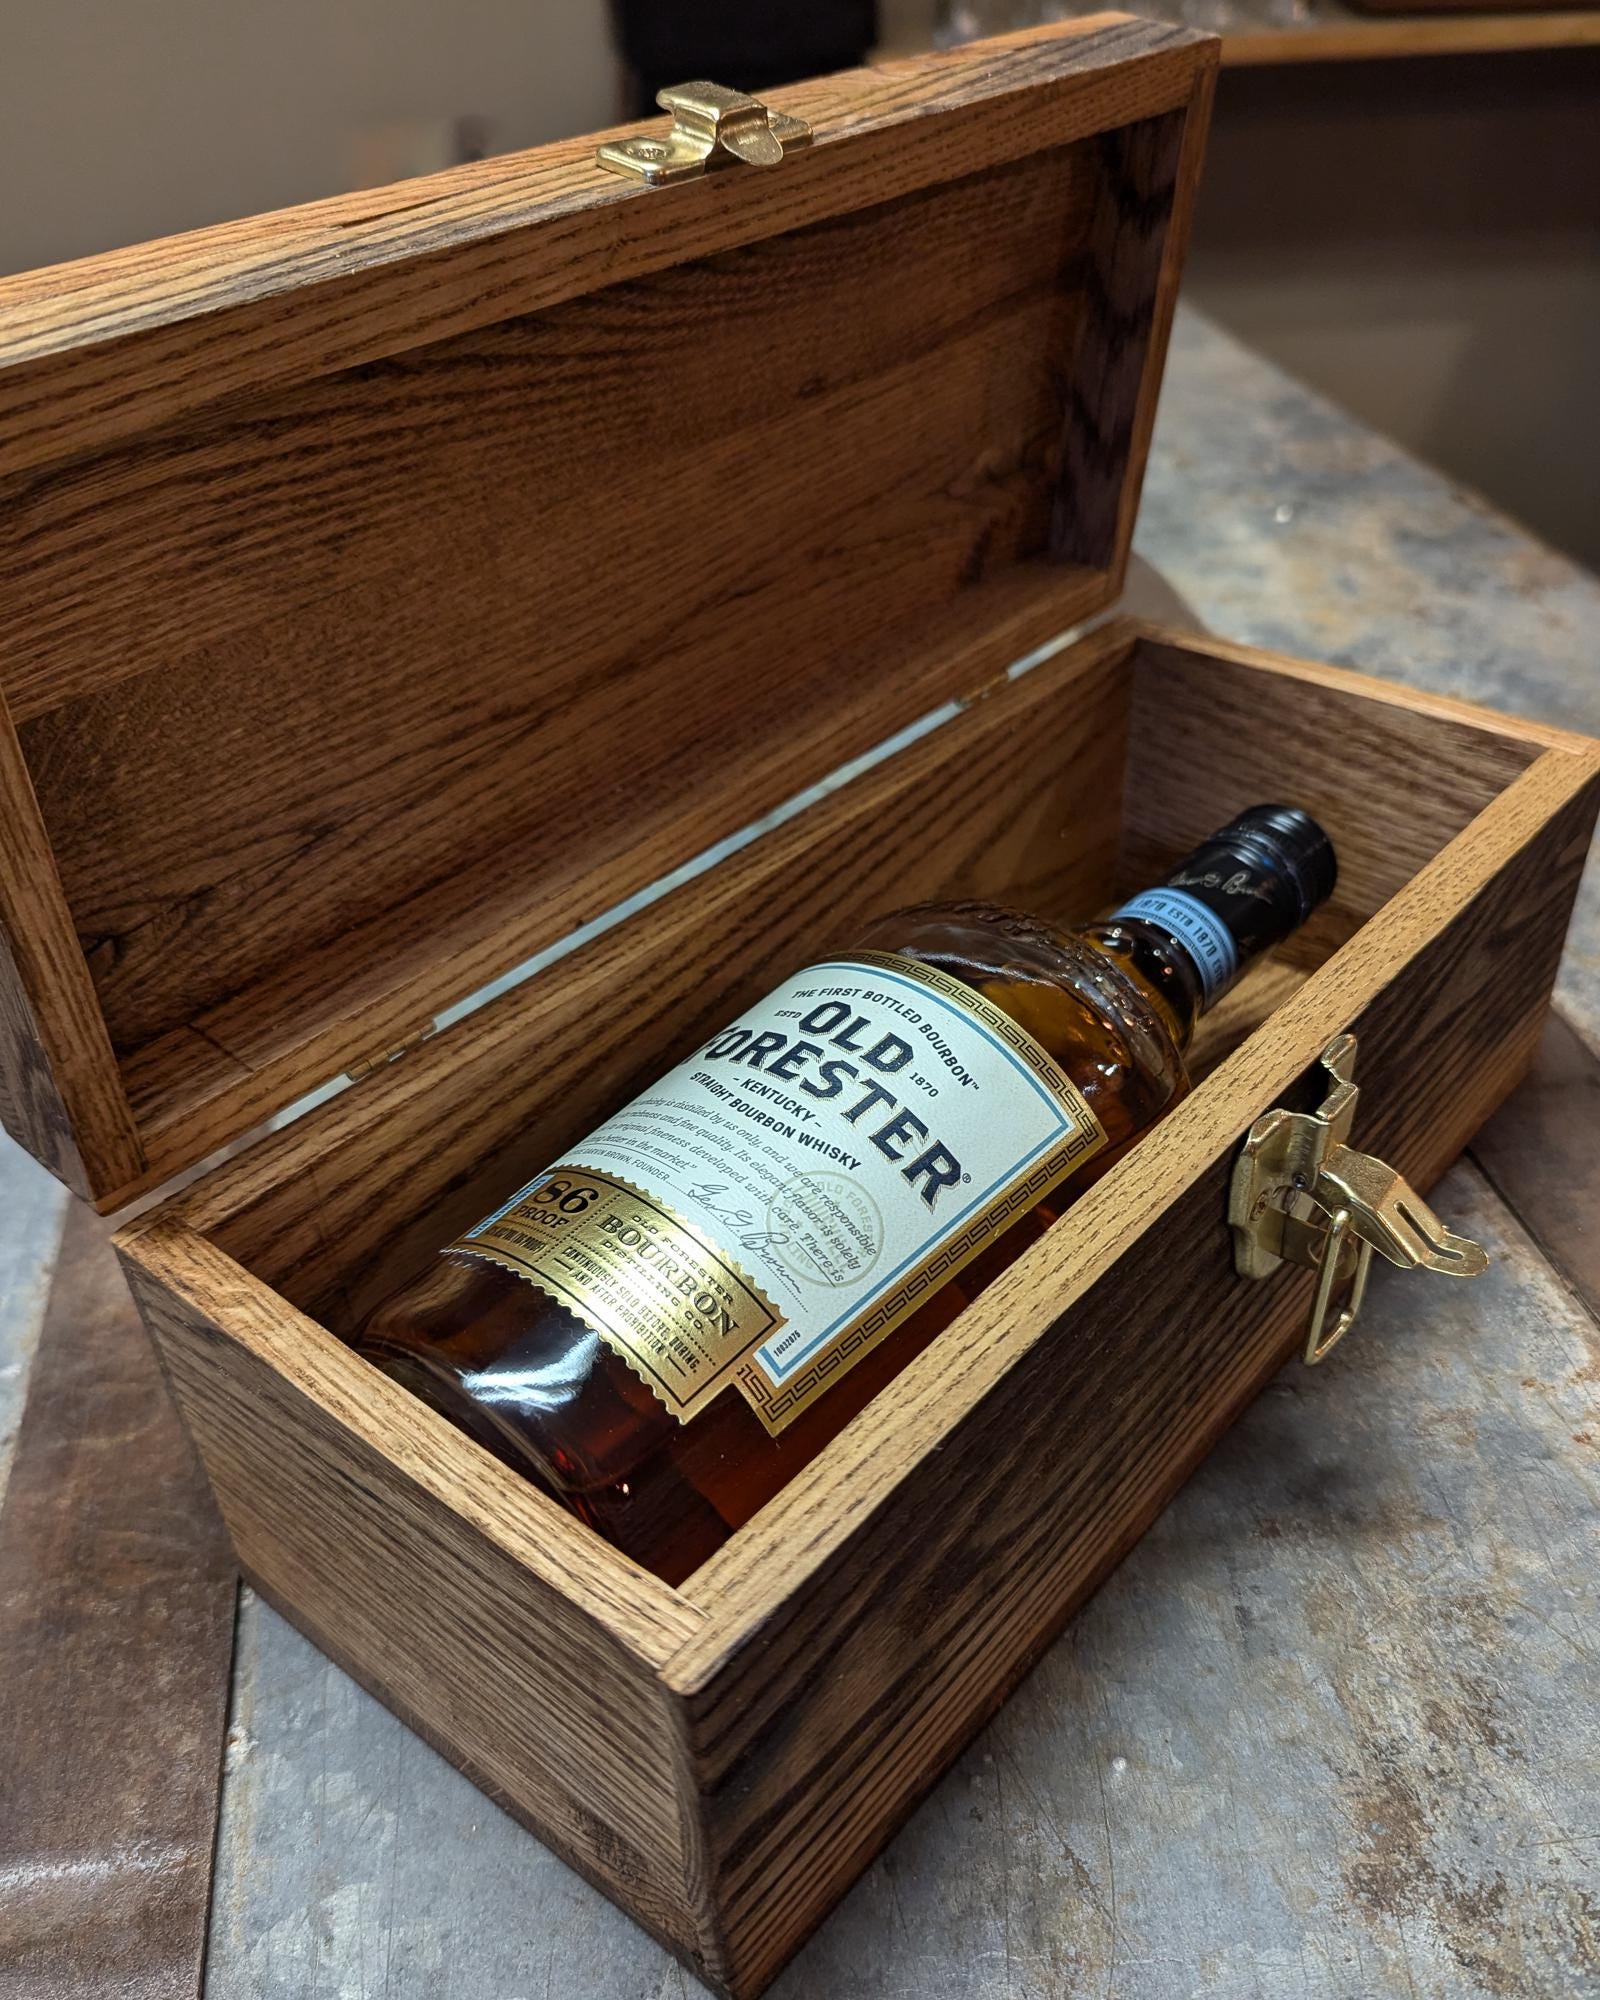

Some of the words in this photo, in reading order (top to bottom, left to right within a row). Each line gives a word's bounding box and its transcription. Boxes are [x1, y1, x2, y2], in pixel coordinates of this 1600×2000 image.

[1192, 925, 1217, 958] 1870
[774, 1010, 801, 1019] ESTD
[792, 988, 815, 999] THE
[818, 987, 862, 998] FIRST
[862, 990, 922, 1025] BOTTLED
[798, 1000, 915, 1075] OLD
[740, 1077, 816, 1122] KENTUCKY
[909, 1071, 940, 1099] 1870
[635, 1140, 654, 1151] the
[690, 1071, 735, 1102] STRAIGHT
[728, 1097, 796, 1139] BOURBON
[798, 1132, 862, 1171] WHISKY
[533, 1180, 600, 1214] 86
[631, 1159, 671, 1181] FOUNDER
[672, 1100, 713, 1119] distilled
[708, 1113, 725, 1125] by
[723, 1120, 739, 1131] us
[736, 1128, 763, 1149] only,
[761, 1145, 789, 1165] and
[785, 1161, 804, 1178] we
[800, 1177, 822, 1195] are
[819, 1194, 877, 1256] responsible
[673, 1116, 699, 1132] fine
[695, 1127, 734, 1152] quality.
[733, 1148, 752, 1163] Its
[749, 1161, 792, 1199] elegant
[790, 1192, 824, 1225] flavor
[820, 1224, 834, 1237] is
[830, 1235, 862, 1270] solely
[511, 1205, 571, 1229] PROOF
[645, 1126, 692, 1149] fineness
[688, 1145, 749, 1184] developed
[744, 1182, 773, 1206] with
[771, 1206, 800, 1234] care.
[800, 1232, 834, 1268] There
[830, 1266, 844, 1282] is
[562, 1246, 619, 1288] CONTINUOUSLY
[616, 1285, 640, 1308] SOLD
[596, 1213, 740, 1337] BOURBON
[600, 1240, 681, 1307] DISTILLING
[684, 1310, 704, 1334] CO.
[632, 1215, 659, 1235] OLD
[661, 1236, 734, 1305] FORESTER
[571, 1270, 593, 1286] AND
[590, 1283, 617, 1307] AFTER
[614, 1303, 667, 1354] PROHIBITION
